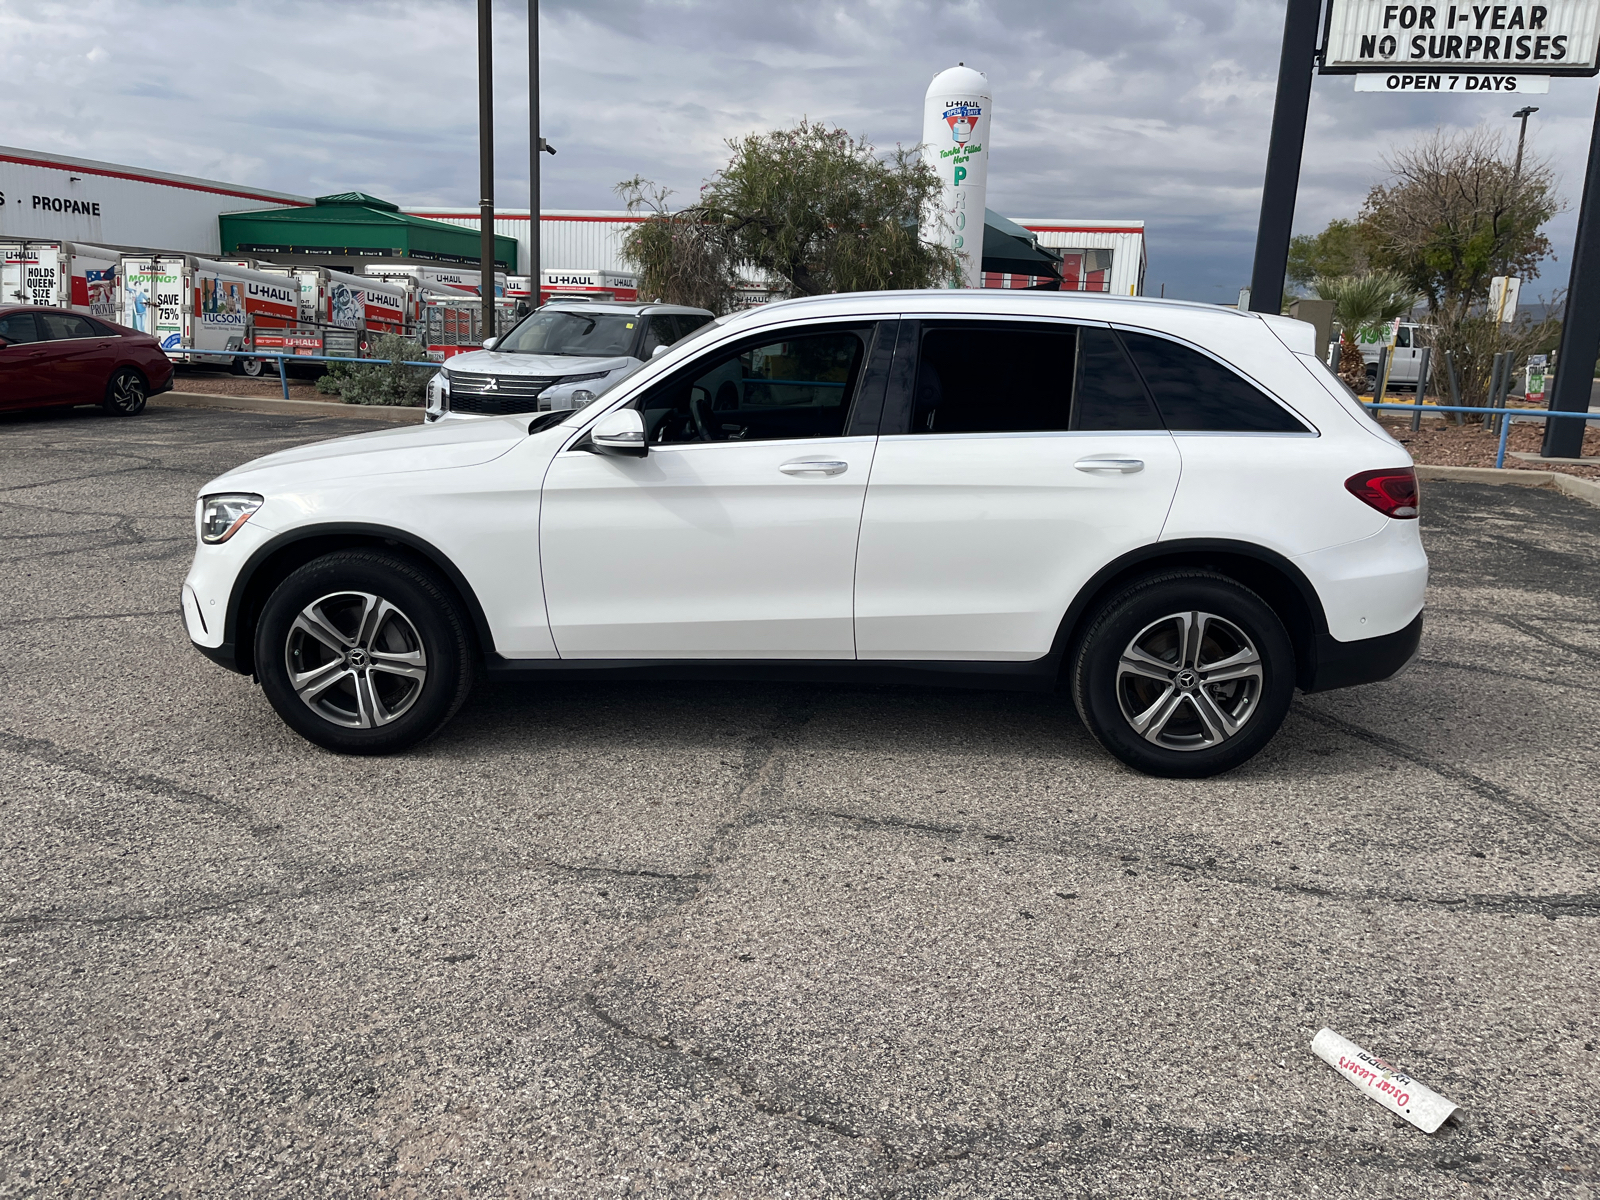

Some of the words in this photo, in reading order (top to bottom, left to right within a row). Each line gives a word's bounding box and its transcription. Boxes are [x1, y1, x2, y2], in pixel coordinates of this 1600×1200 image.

[1383, 6, 1436, 29] FOR
[1359, 35, 1397, 59] NO
[1410, 35, 1568, 60] SURPRISES
[1386, 75, 1441, 90] OPEN
[1448, 76, 1459, 89] 7
[1465, 76, 1517, 91] DAYS
[946, 109, 961, 117] OPEN
[940, 147, 960, 158] Tanks
[963, 143, 982, 155] Filled
[953, 156, 969, 164] Here
[32, 195, 100, 216] PROPANE
[6, 251, 39, 259] U-HAUL
[28, 268, 55, 278] HOLDS
[27, 279, 57, 288] QUEEN-
[128, 275, 178, 283] MOVING?
[436, 275, 462, 284] U-HAUL
[548, 276, 595, 285] U-HAUL
[613, 279, 634, 288] U-HAUL
[33, 289, 51, 298] SIZE
[248, 283, 293, 302] U-HAUL
[157, 294, 179, 306] SAVE
[367, 292, 400, 308] U-HAUL
[158, 308, 179, 320] 75%
[203, 313, 241, 324] TUCSON
[285, 338, 320, 346] U-HAUL
[1338, 1056, 1377, 1086] Leeser's
[1376, 1080, 1410, 1107] Oscar
